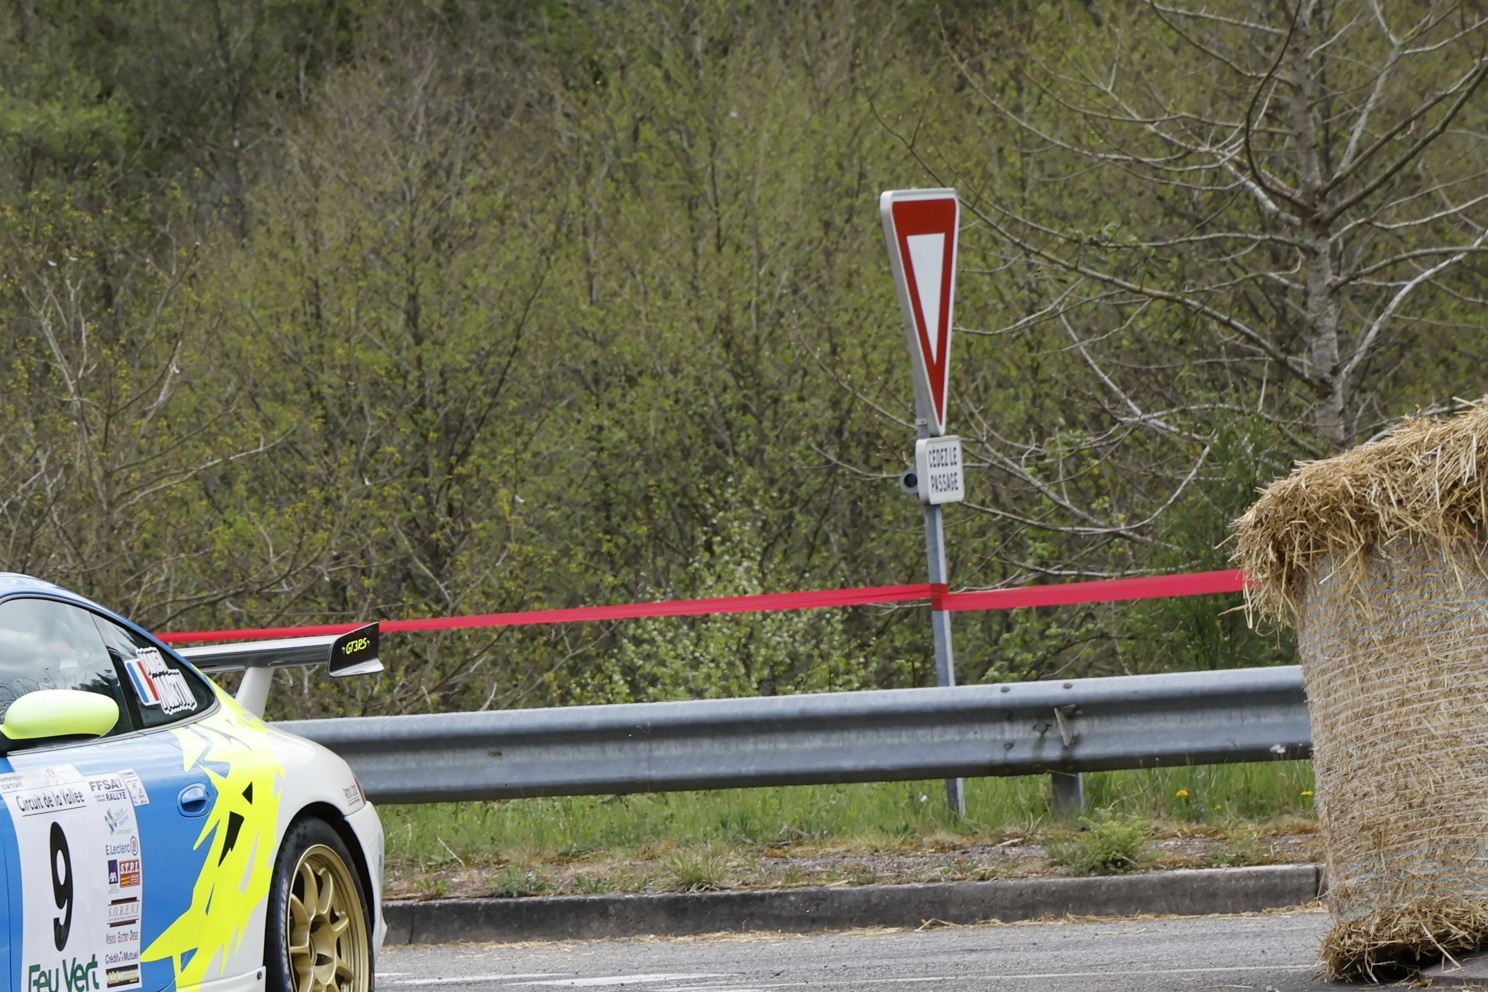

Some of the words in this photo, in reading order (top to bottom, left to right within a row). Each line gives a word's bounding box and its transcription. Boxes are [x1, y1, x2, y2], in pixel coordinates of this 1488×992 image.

[929, 445, 948, 468] CÉDEZ
[949, 447, 957, 466] LE
[930, 472, 959, 493] PASSAGE
[88, 778, 120, 792] FFSA
[16, 792, 44, 813] Circuit
[44, 790, 54, 810] de
[55, 788, 63, 807] la
[62, 787, 85, 807] Vallée
[105, 791, 127, 802] RALLYE
[50, 821, 73, 952] 9
[123, 950, 139, 961] Mutuel
